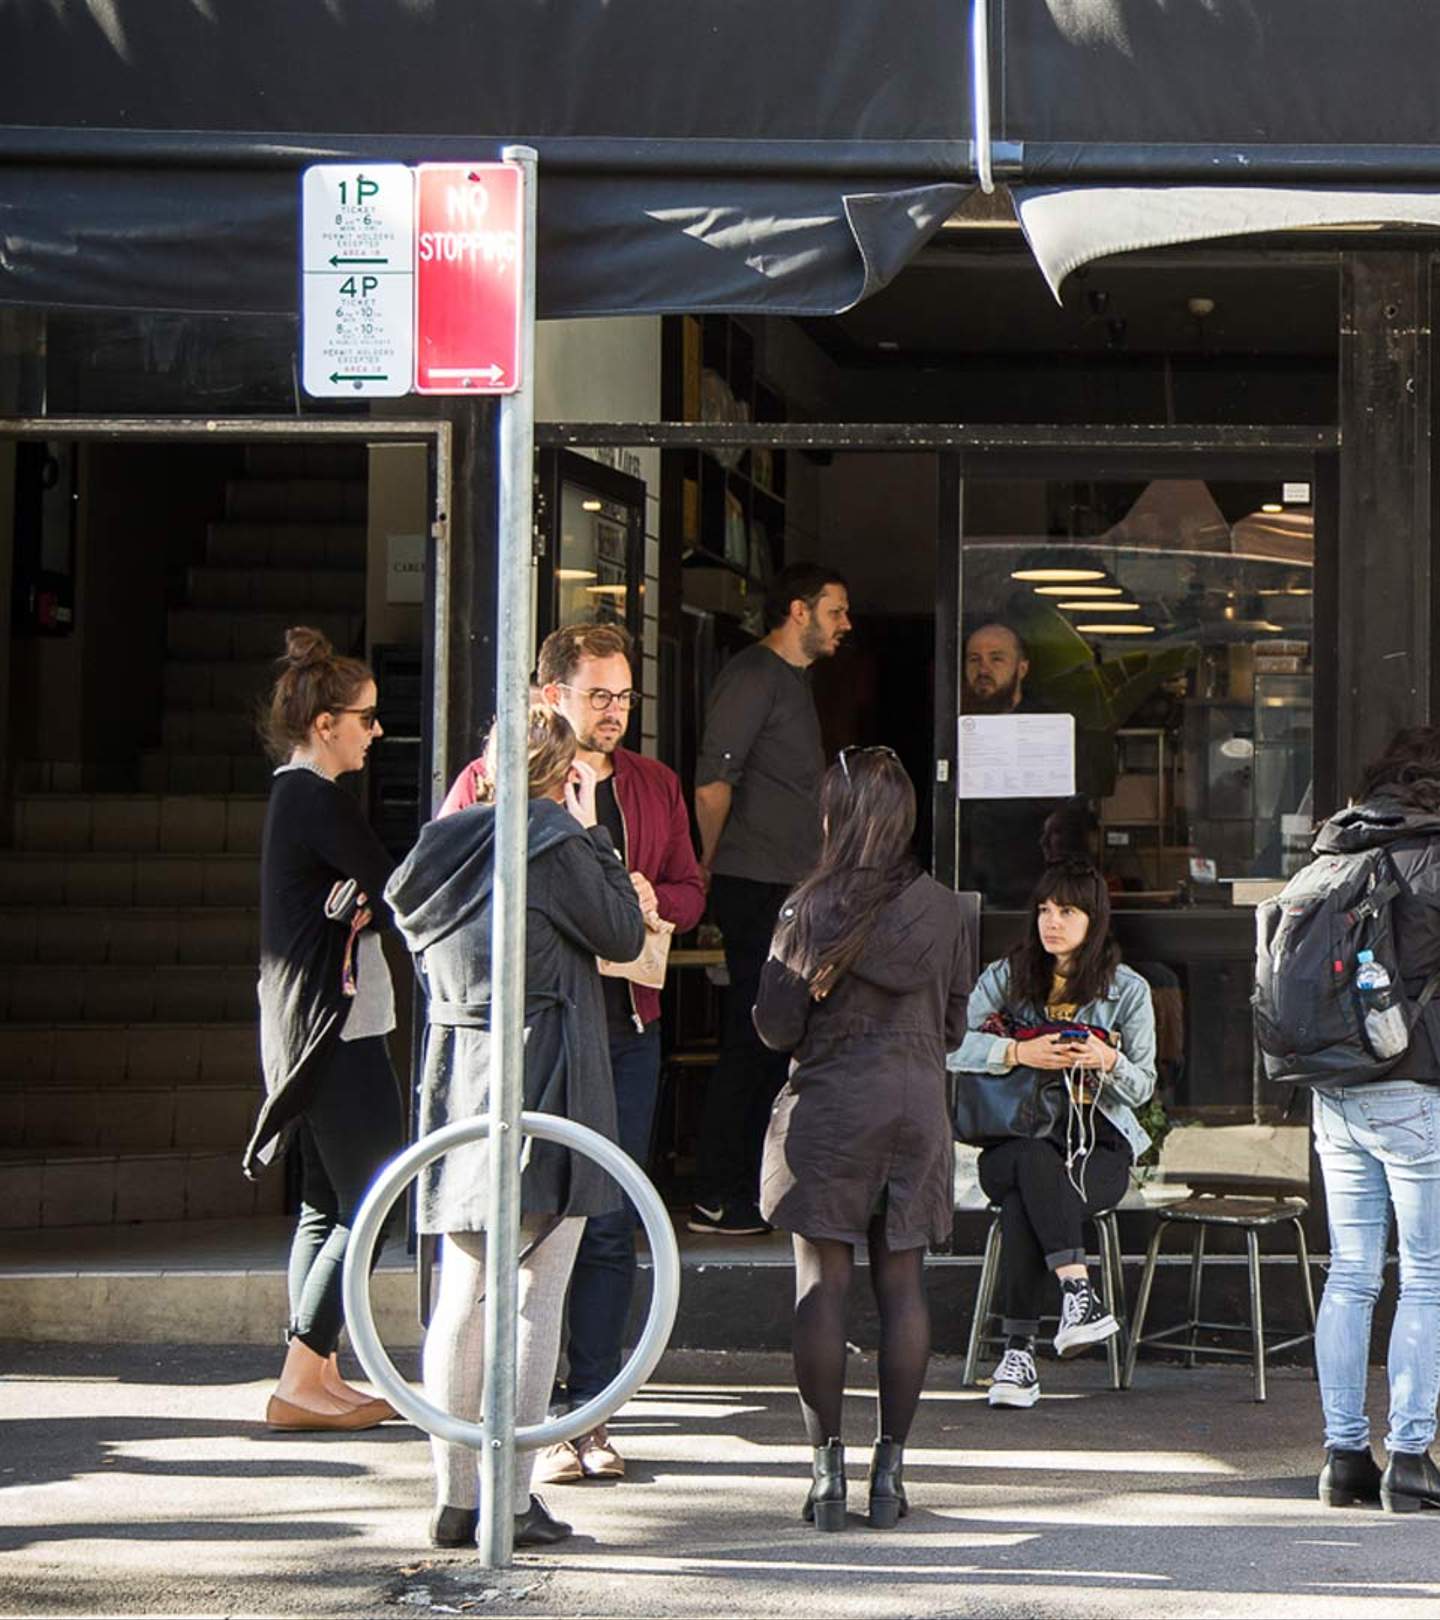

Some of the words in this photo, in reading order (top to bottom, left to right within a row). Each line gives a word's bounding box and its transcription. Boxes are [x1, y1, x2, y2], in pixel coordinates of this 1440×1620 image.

[338, 181, 380, 206] 1P
[446, 185, 489, 218] NO
[339, 276, 379, 299] 4P
